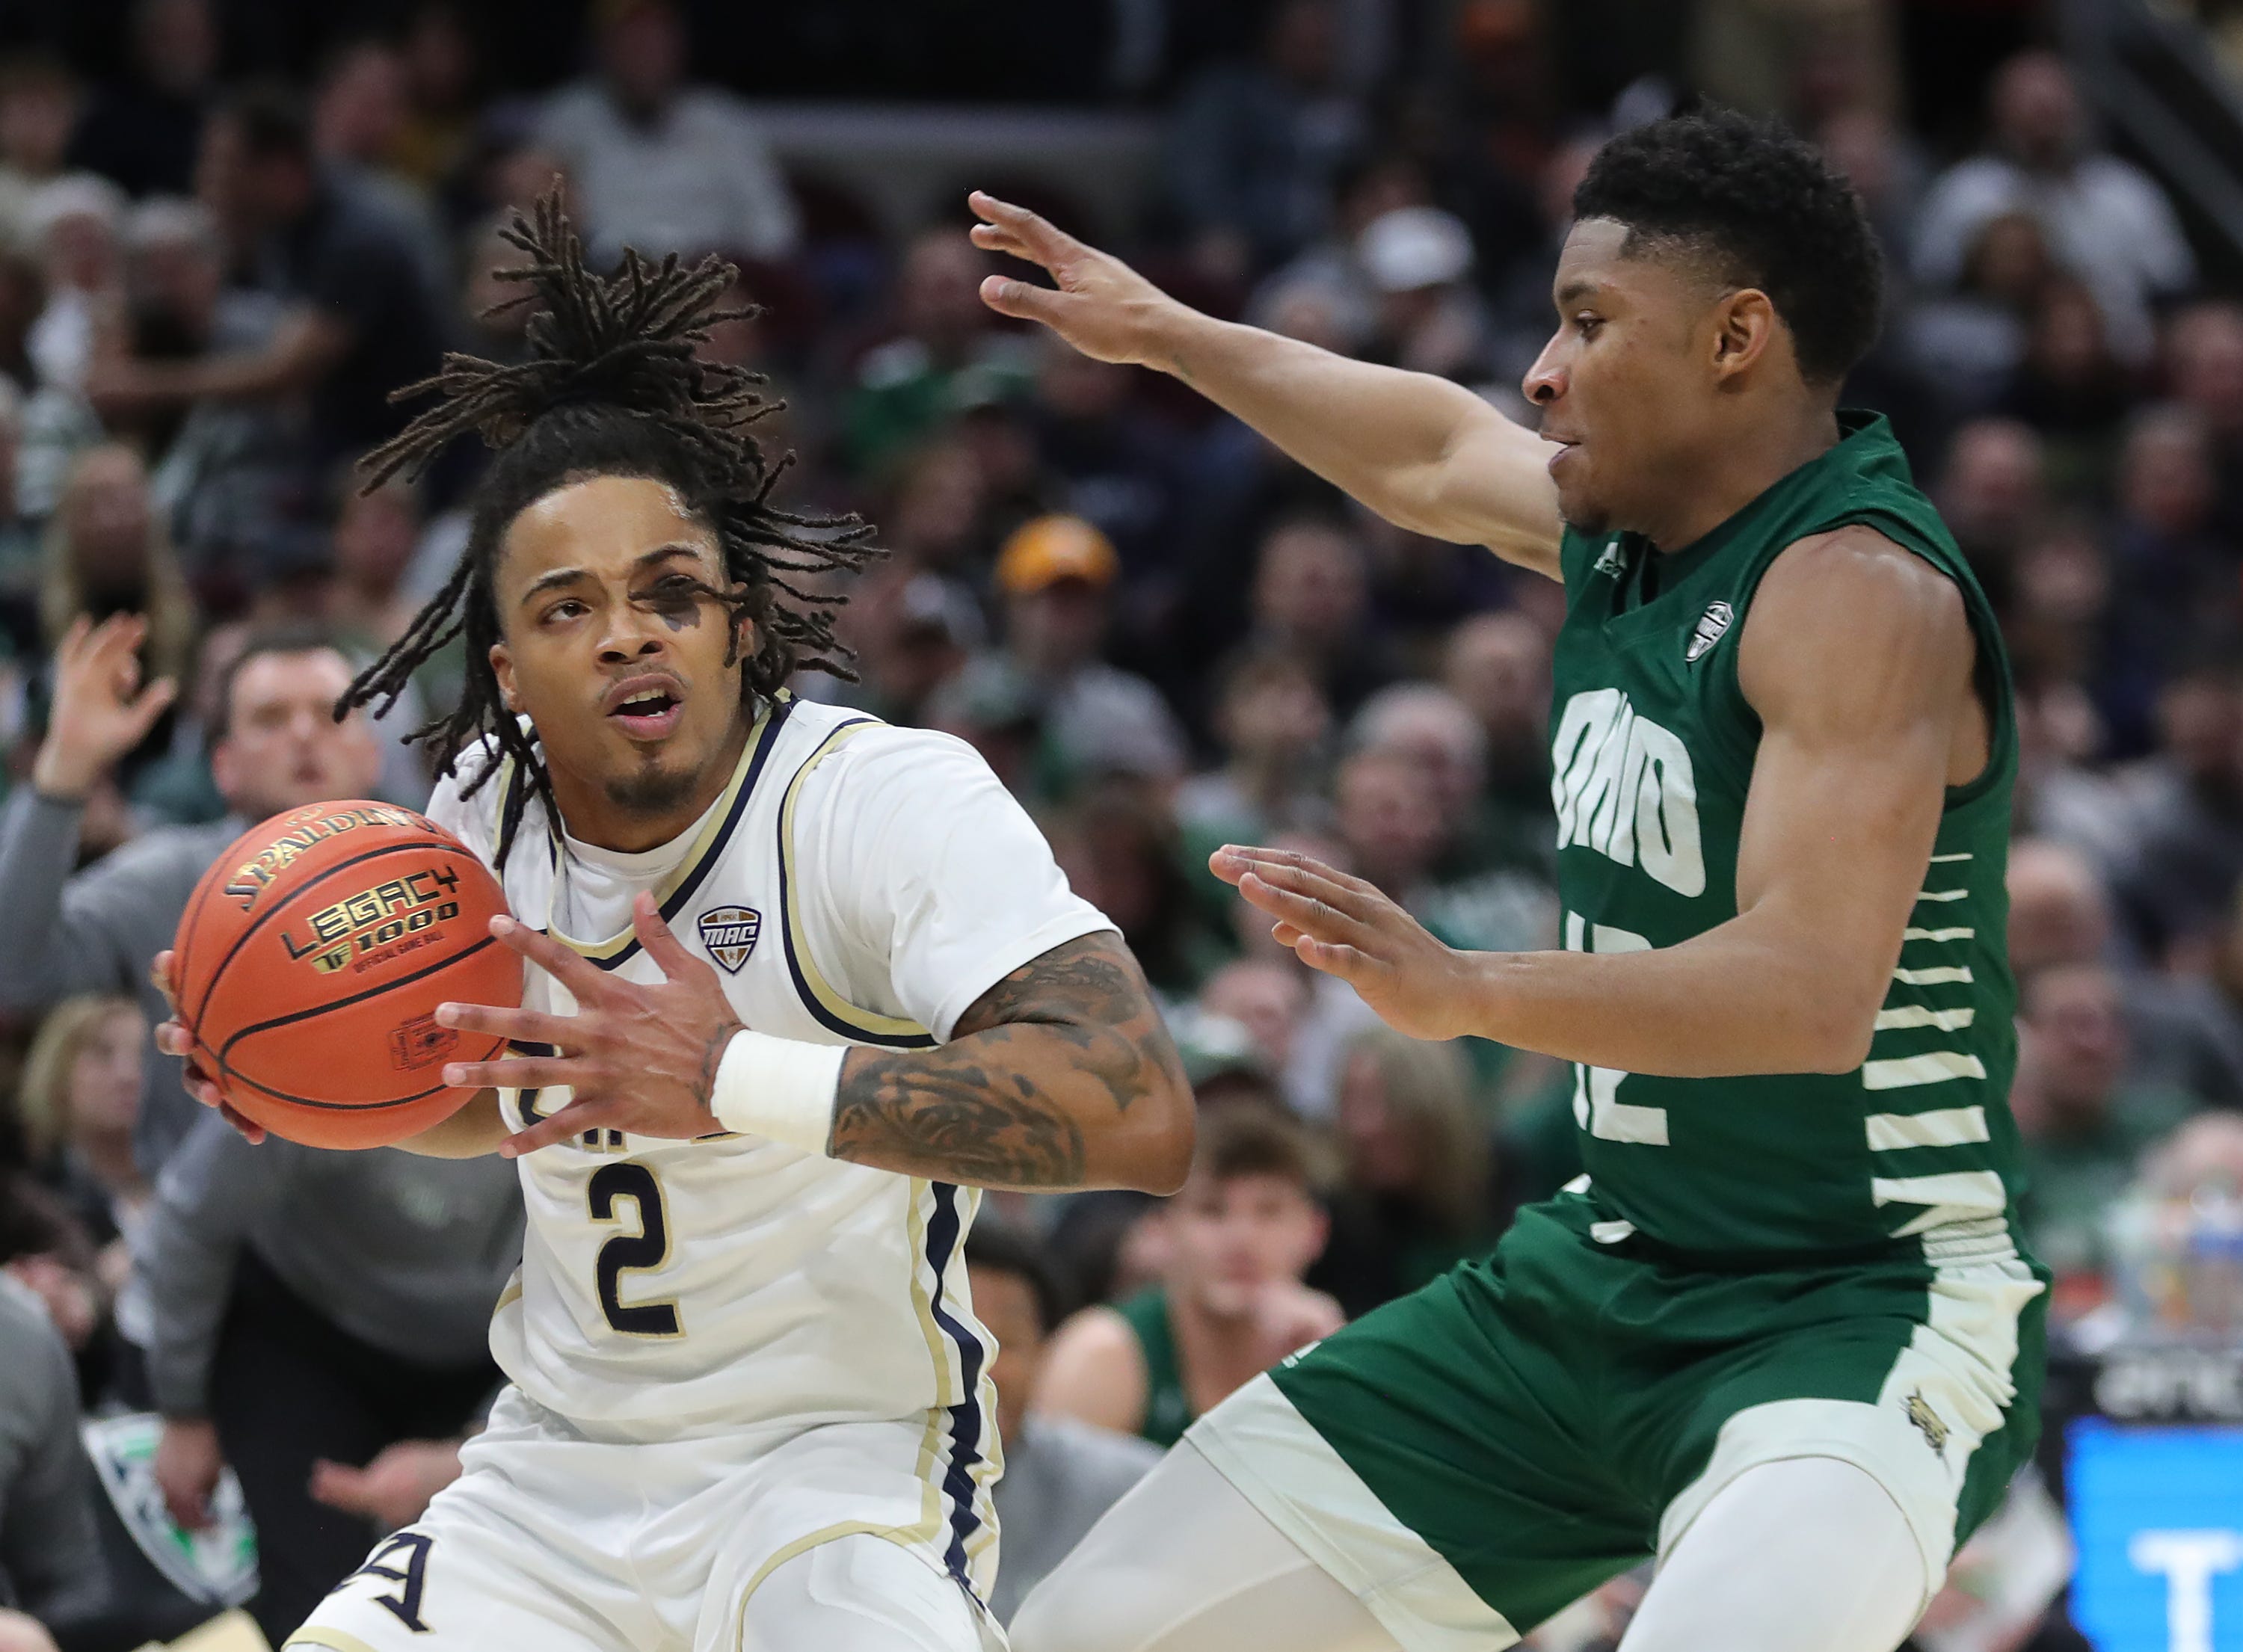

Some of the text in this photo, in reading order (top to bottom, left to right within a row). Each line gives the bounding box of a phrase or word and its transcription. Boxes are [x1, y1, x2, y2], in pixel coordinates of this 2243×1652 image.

[281, 866, 460, 961] LEGACY
[311, 901, 459, 973] TF 1000
[397, 937, 424, 954] GAME
[703, 925, 757, 946] MAC
[586, 1159, 686, 1339] 2
